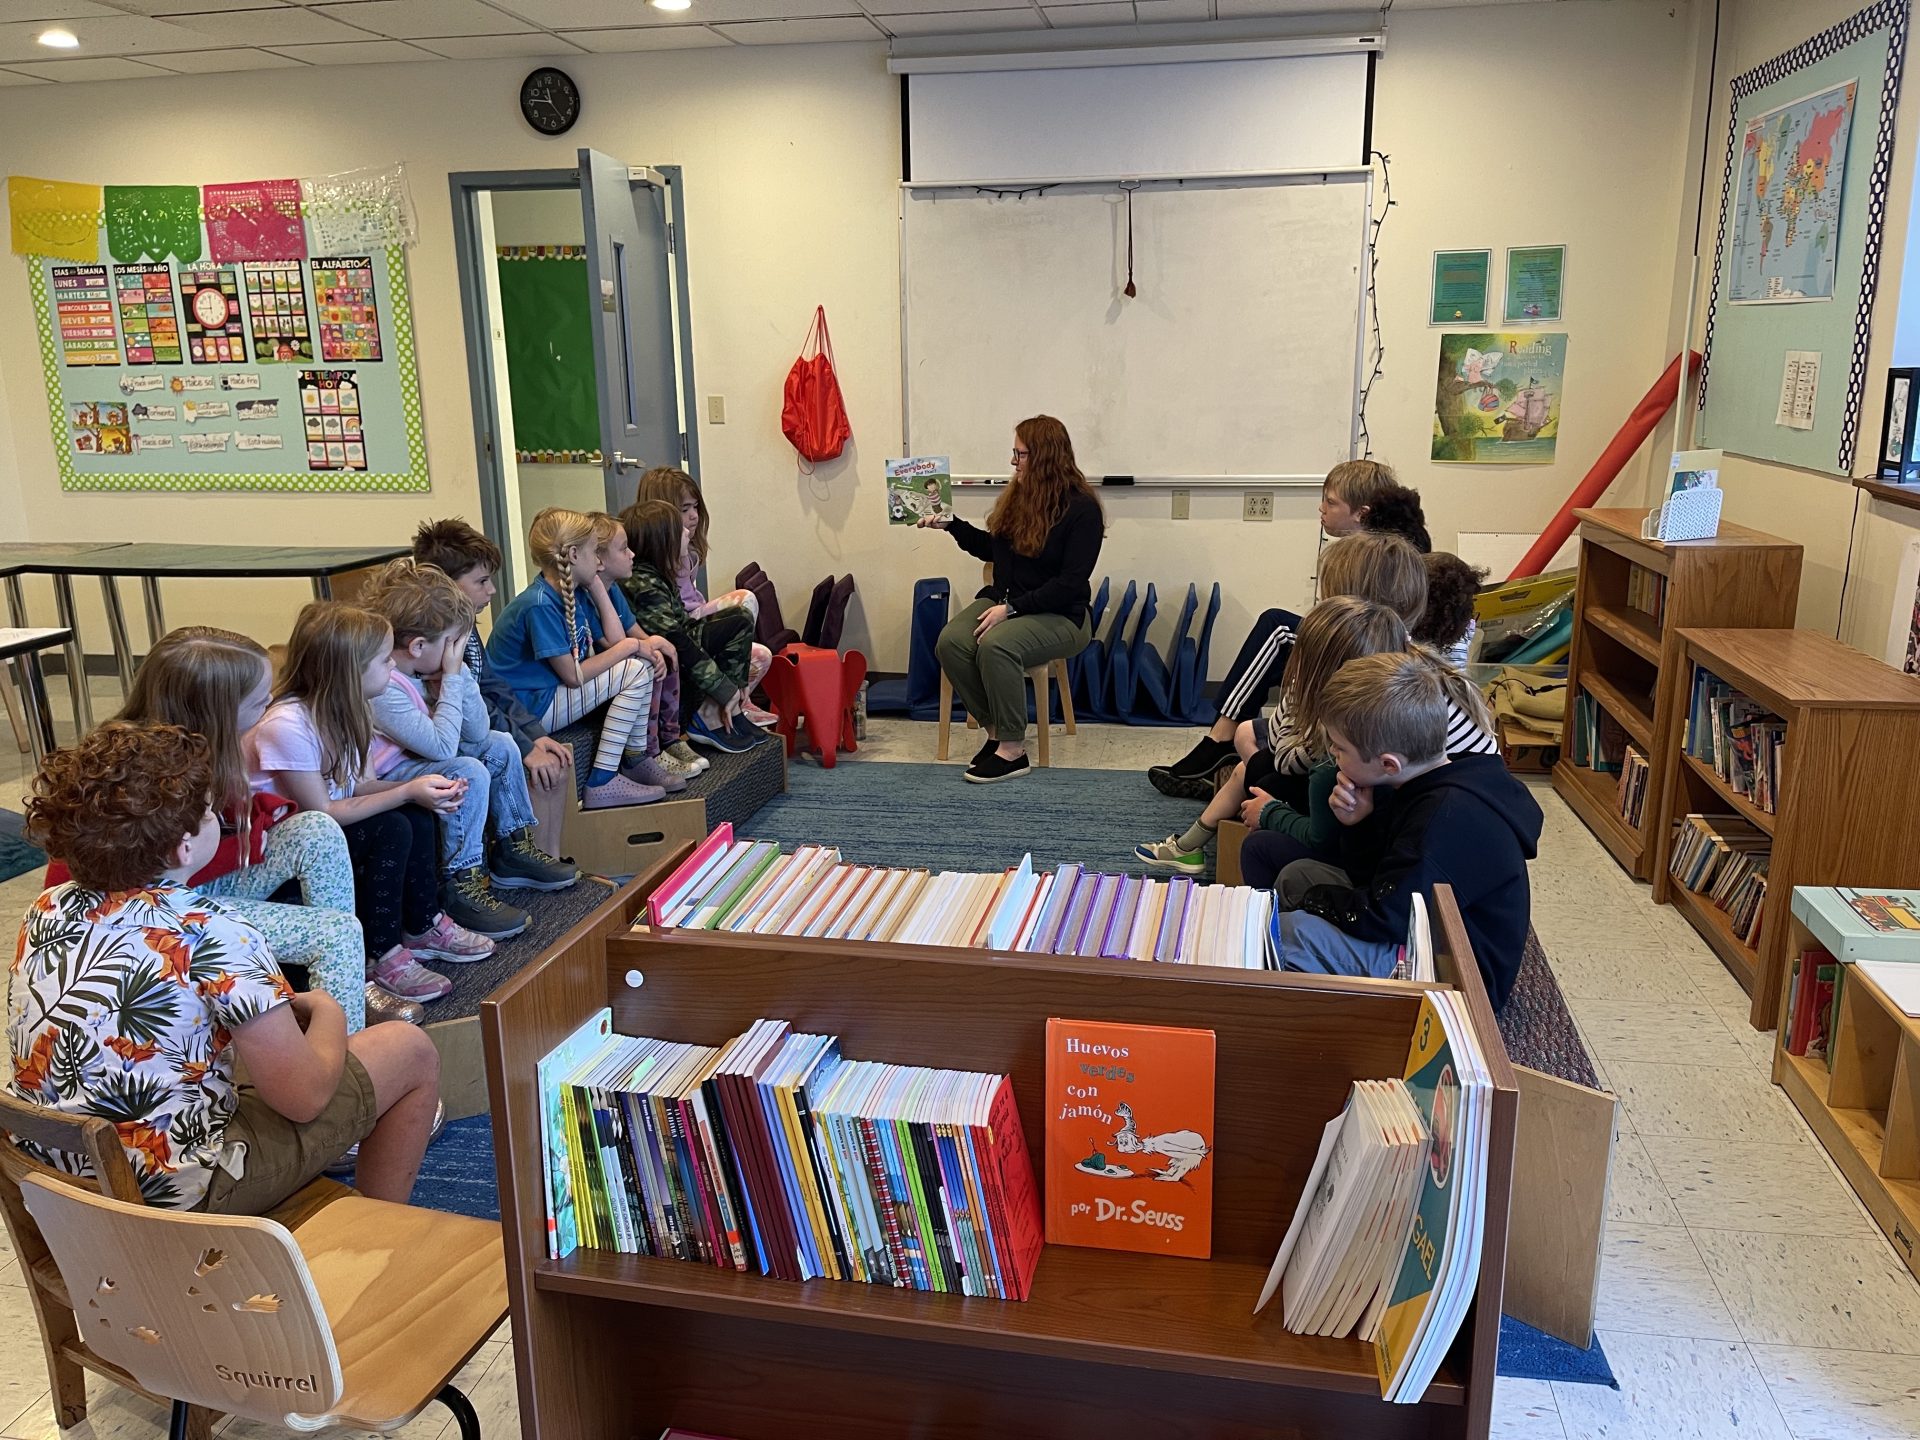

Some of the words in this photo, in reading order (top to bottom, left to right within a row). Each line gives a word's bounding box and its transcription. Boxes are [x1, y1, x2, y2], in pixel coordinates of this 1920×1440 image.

[153, 264, 168, 272] AÑO
[322, 260, 360, 269] ALFABETO
[77, 267, 104, 275] SEMANA
[57, 291, 87, 299] MARTES
[62, 316, 85, 324] JUEVES
[304, 372, 314, 380] EL
[318, 371, 349, 380] TIEMPO
[319, 380, 338, 389] HOY
[894, 462, 936, 476] Everybody
[1066, 1038, 1129, 1058] Huevos
[1080, 1062, 1135, 1083] verdes
[1067, 1084, 1098, 1099] con
[1059, 1103, 1112, 1125] jamón
[1071, 1202, 1091, 1216] por
[1095, 1198, 1127, 1222] Dr.
[1130, 1200, 1185, 1232] Seuss
[215, 1363, 318, 1394] Squirrel
